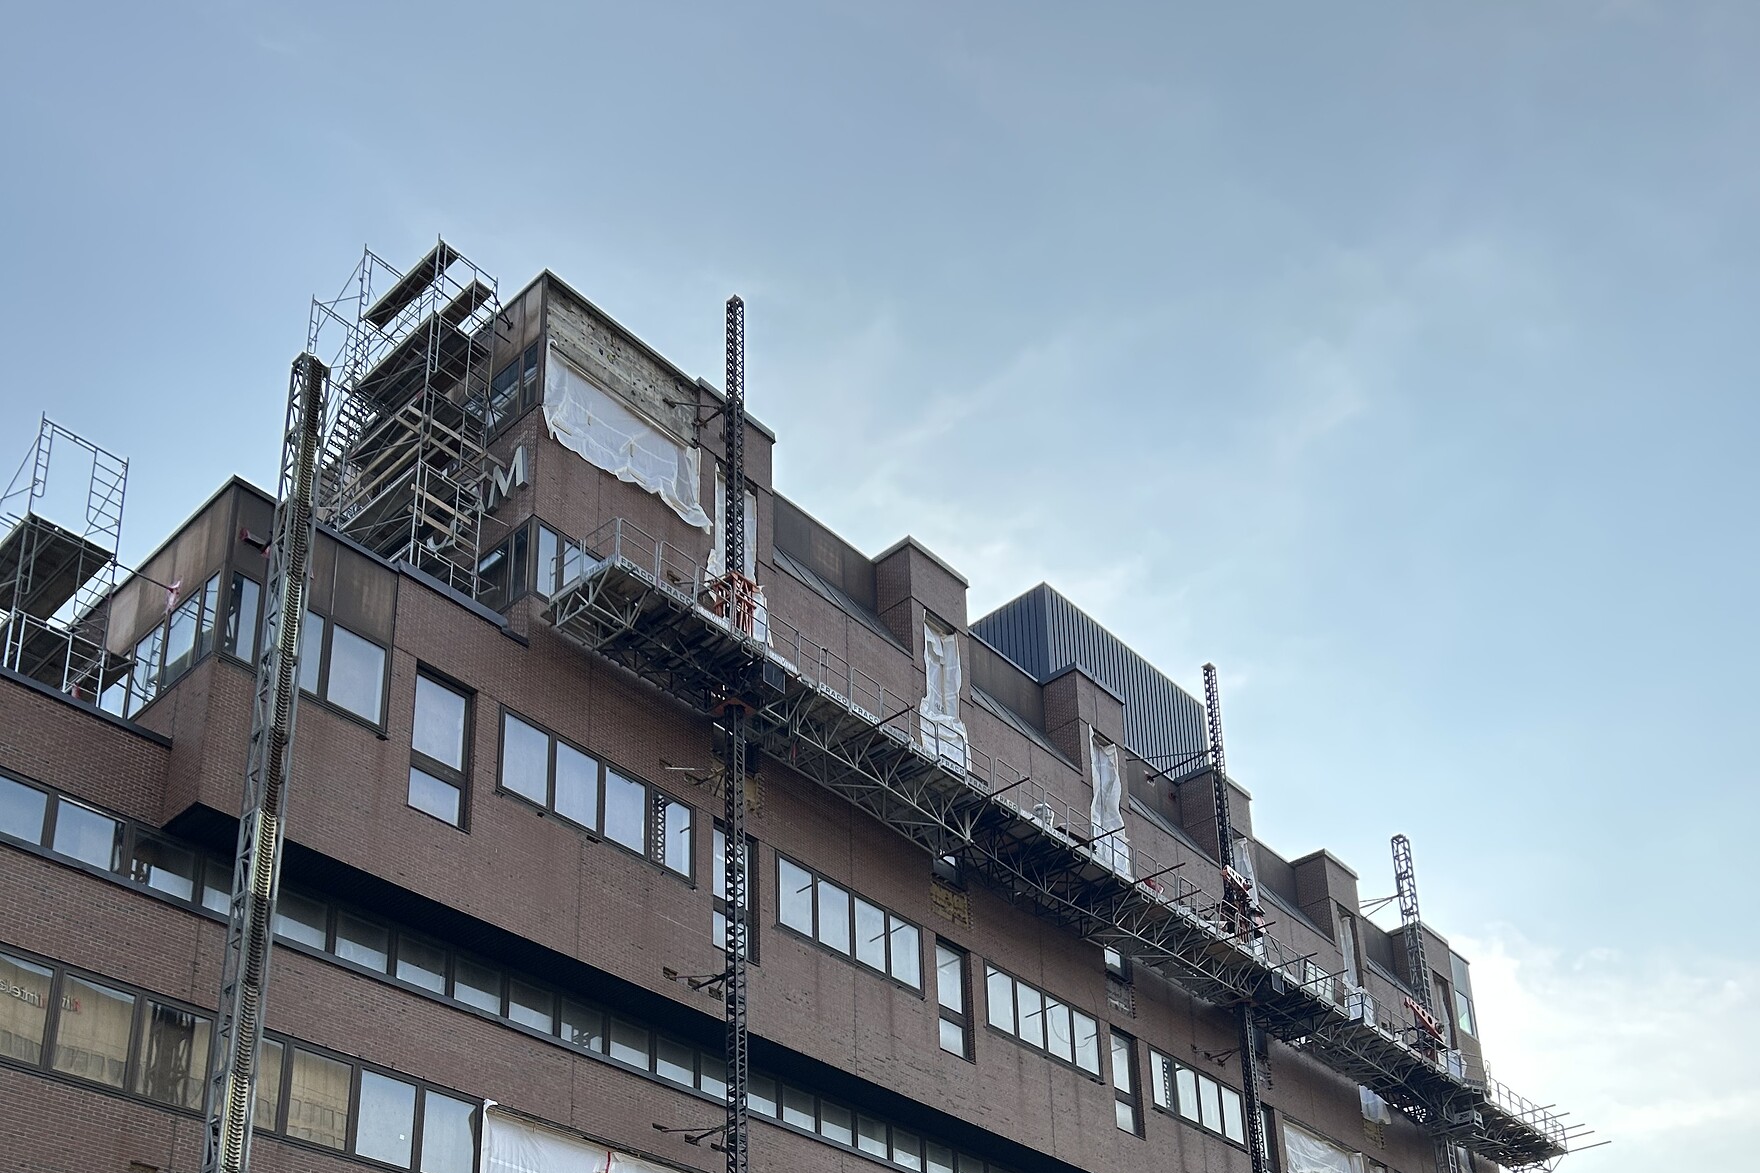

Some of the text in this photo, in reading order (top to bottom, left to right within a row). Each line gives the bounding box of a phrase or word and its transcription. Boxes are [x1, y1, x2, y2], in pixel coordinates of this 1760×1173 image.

[621, 557, 654, 583] FRACO
[821, 683, 848, 705] FRACO
[853, 705, 880, 724] FRACO
